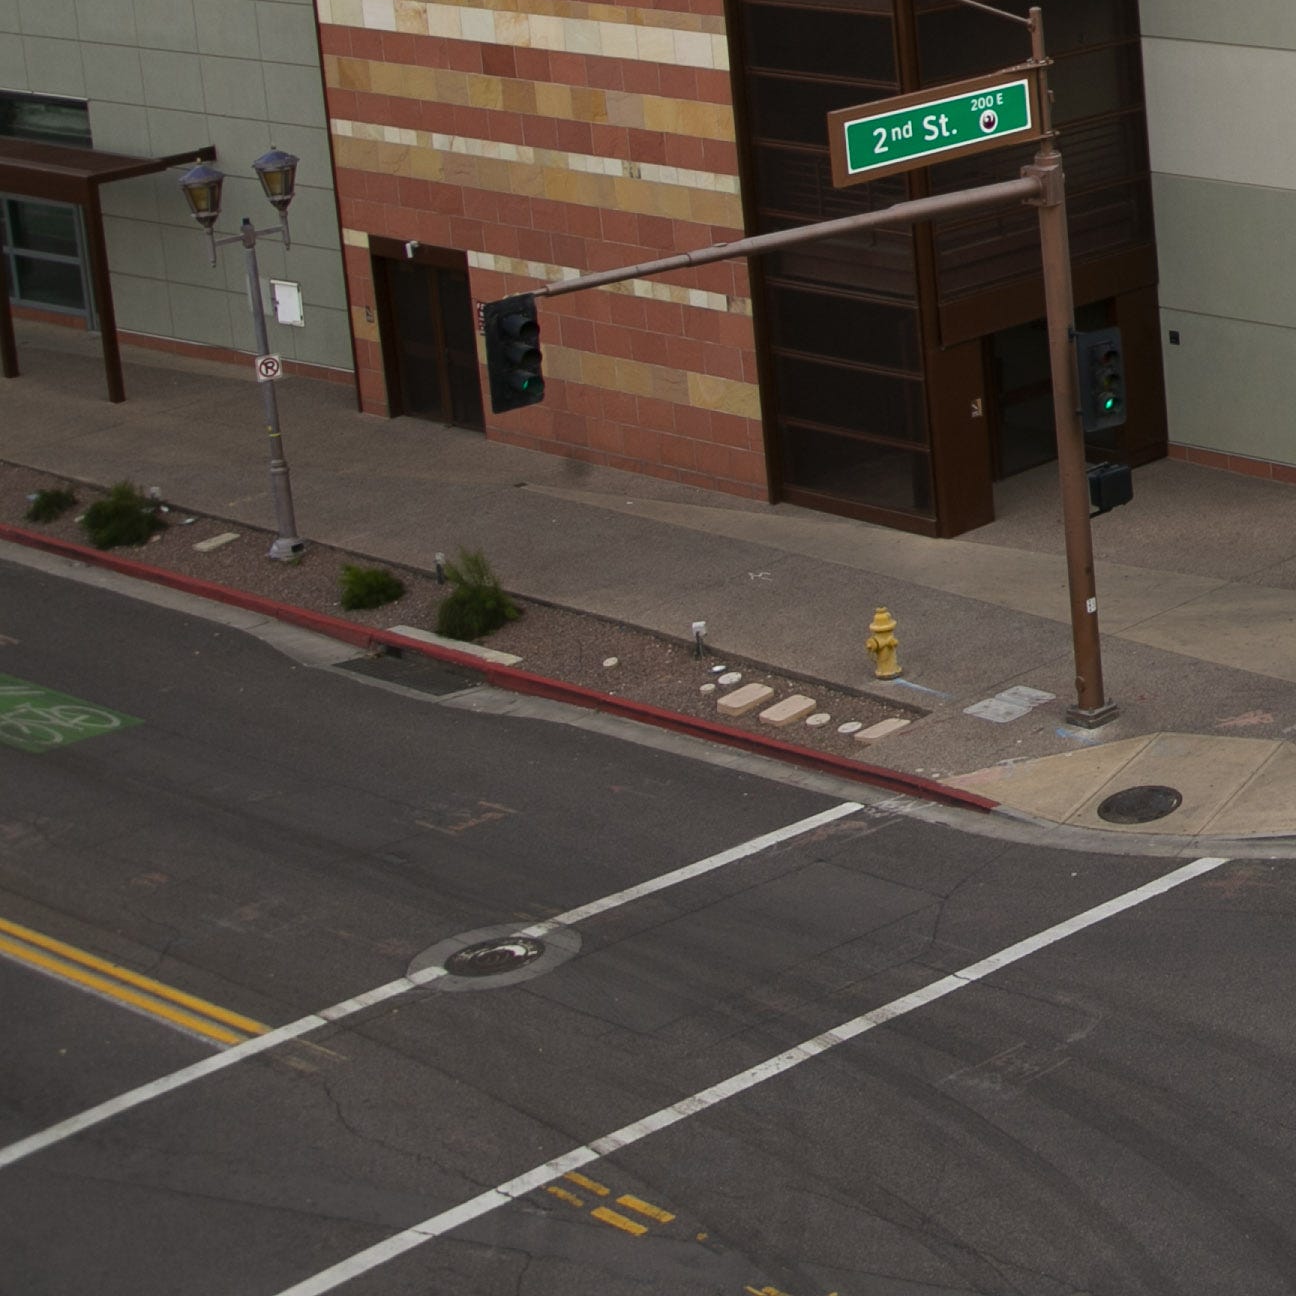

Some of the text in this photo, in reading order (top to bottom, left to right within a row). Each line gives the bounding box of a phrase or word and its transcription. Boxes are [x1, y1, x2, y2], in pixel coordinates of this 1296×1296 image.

[970, 92, 1003, 111] 200 E
[872, 113, 958, 154] 2nd St.
